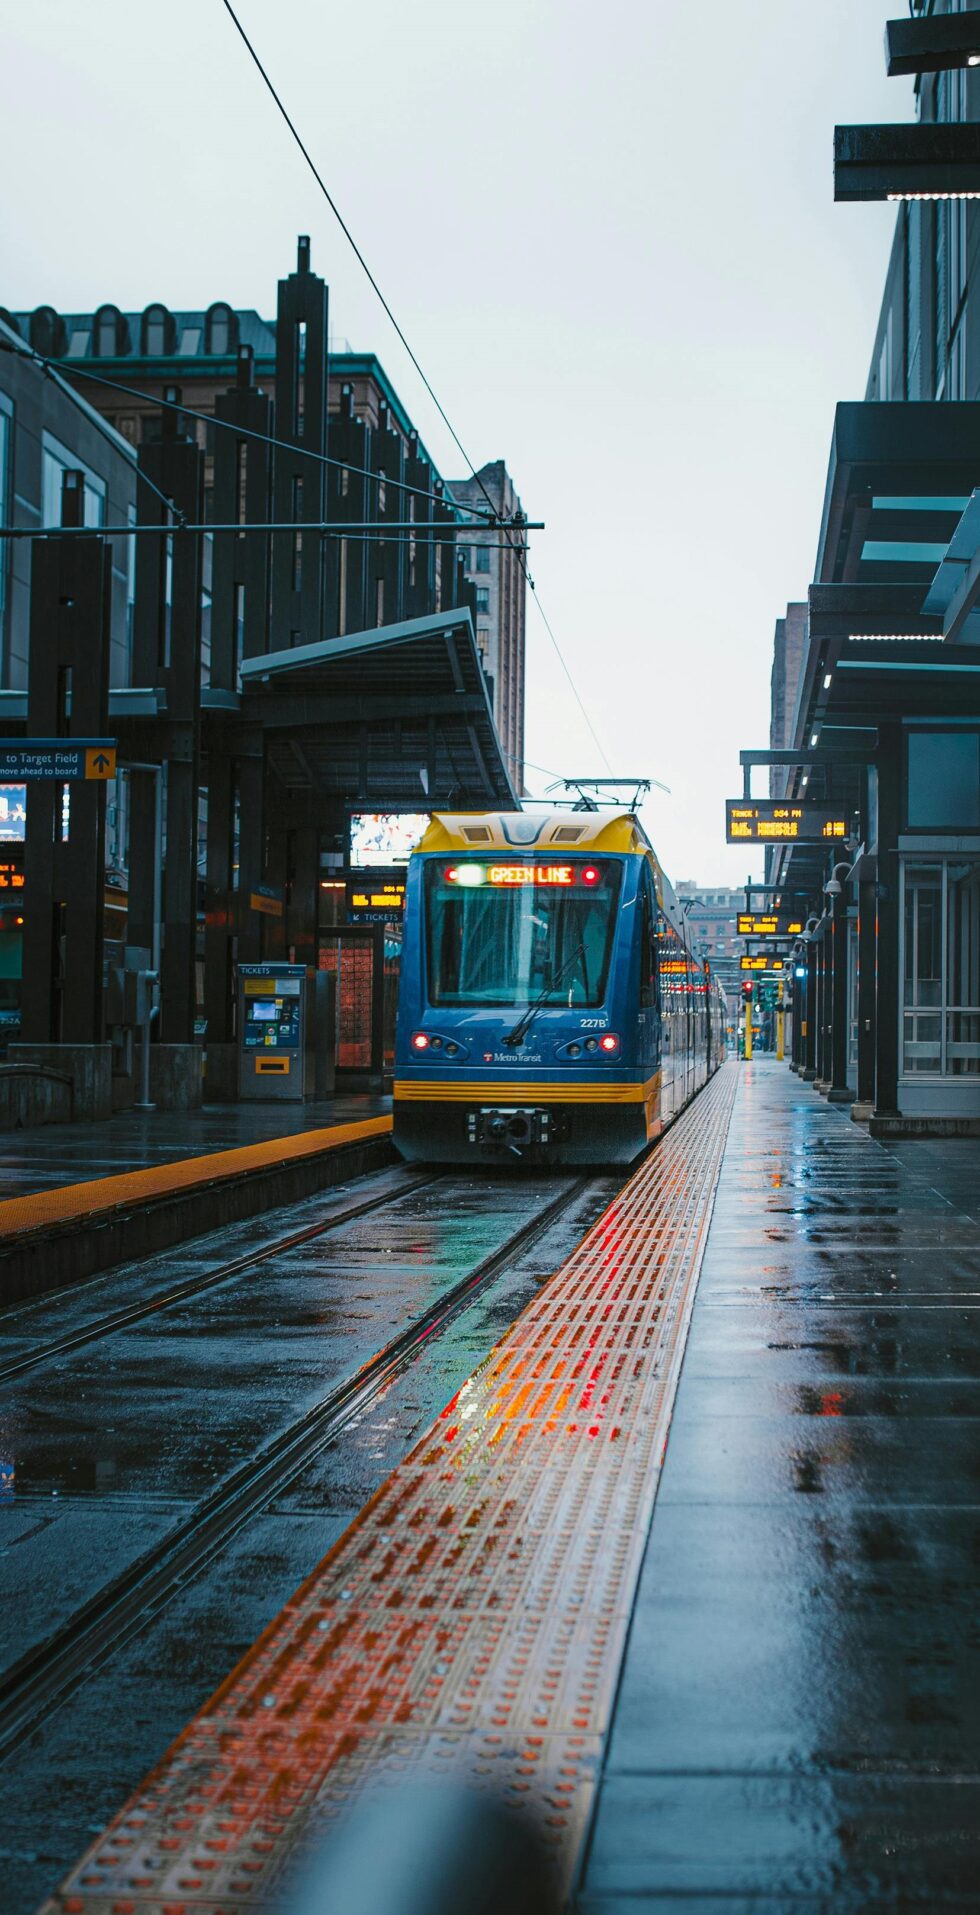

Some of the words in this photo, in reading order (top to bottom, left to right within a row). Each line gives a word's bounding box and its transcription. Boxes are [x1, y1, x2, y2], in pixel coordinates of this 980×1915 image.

[6, 755, 17, 764] to
[19, 752, 52, 766] Target
[55, 752, 78, 764] Field
[20, 766, 42, 775] ahead
[44, 767, 53, 775] to
[55, 766, 78, 775] board
[490, 867, 534, 883] GREEN
[538, 867, 572, 883] LINE
[364, 913, 398, 921] TICKETS
[240, 967, 270, 975] TICKETS
[580, 1018, 606, 1028] 227B
[494, 1053, 517, 1062] Metro
[518, 1053, 541, 1062] Transit
